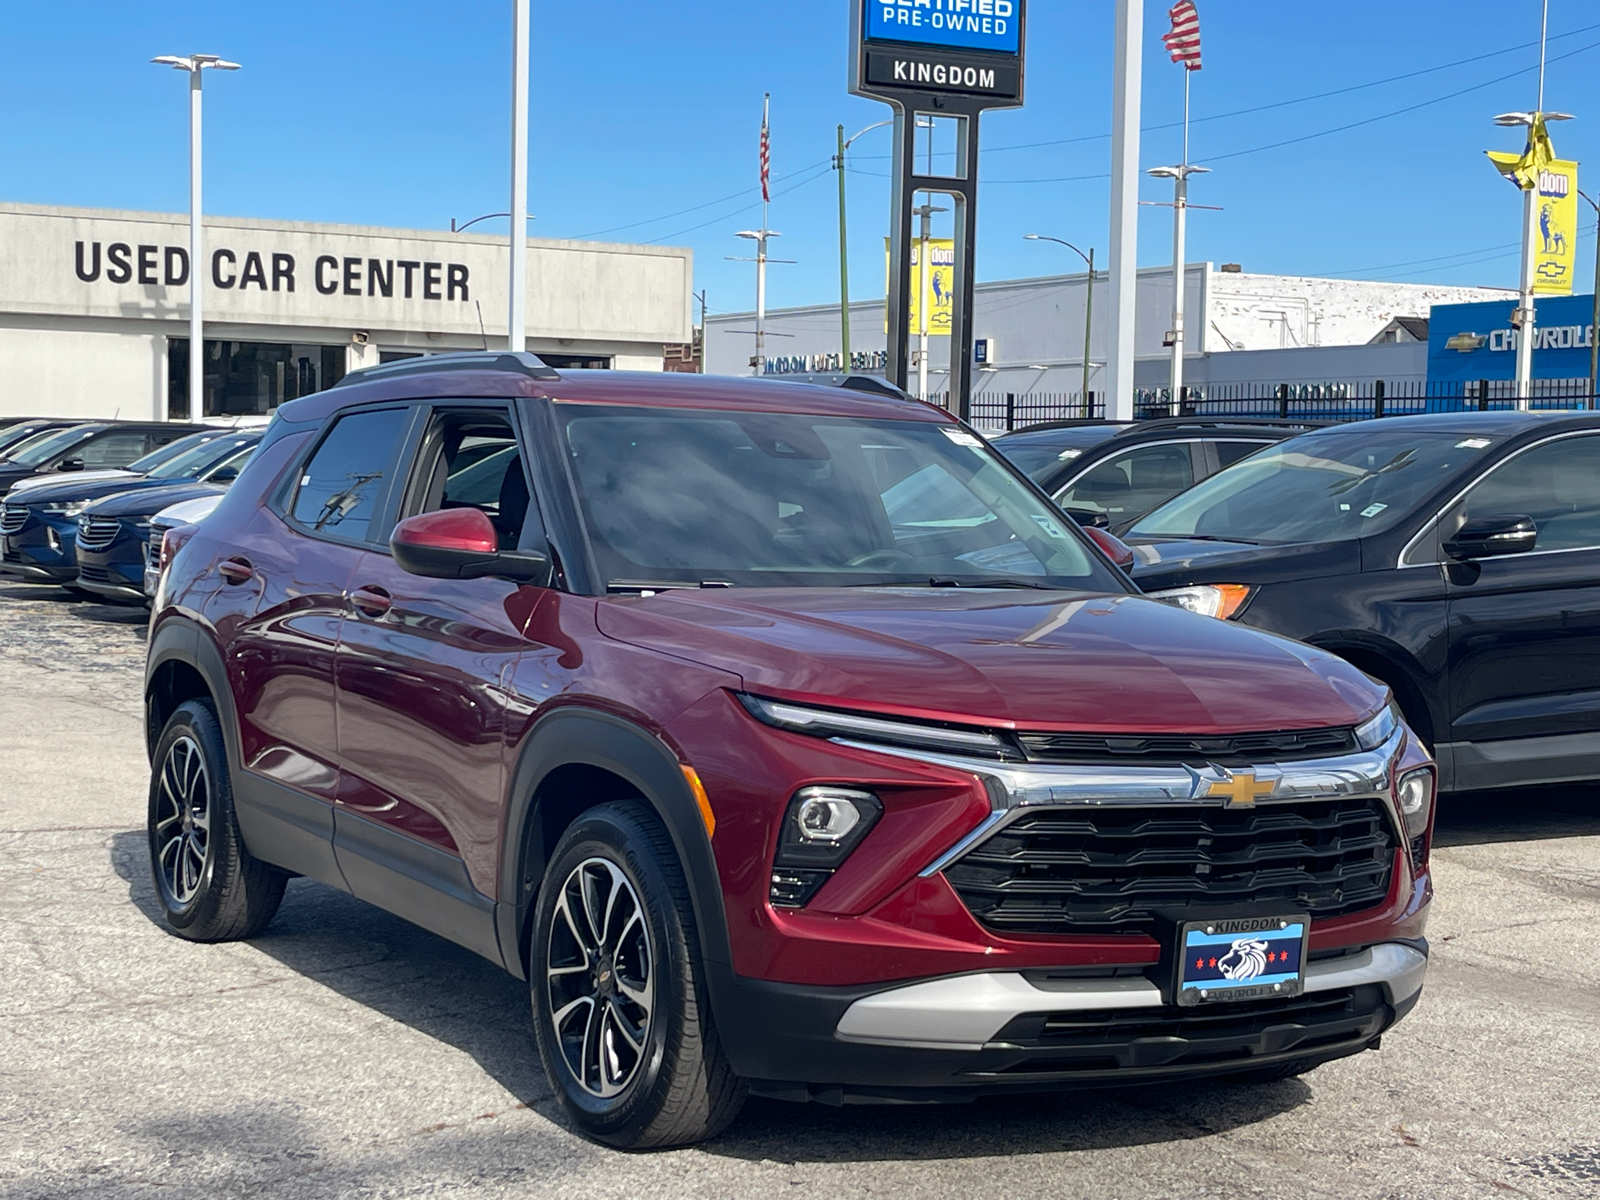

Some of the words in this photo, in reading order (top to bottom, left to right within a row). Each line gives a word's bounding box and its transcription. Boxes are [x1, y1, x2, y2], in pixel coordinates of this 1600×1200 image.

[883, 7, 1007, 35] PRE-OWNED
[894, 60, 995, 88] KINGDOM
[1539, 169, 1568, 197] dom
[75, 241, 190, 286] USED
[212, 248, 296, 293] CAR
[315, 255, 470, 302] CENTER
[1489, 325, 1600, 351] CHVROLE
[764, 356, 809, 374] INGDOM
[849, 350, 888, 370] CENTE
[1214, 917, 1281, 933] KINGDOM
